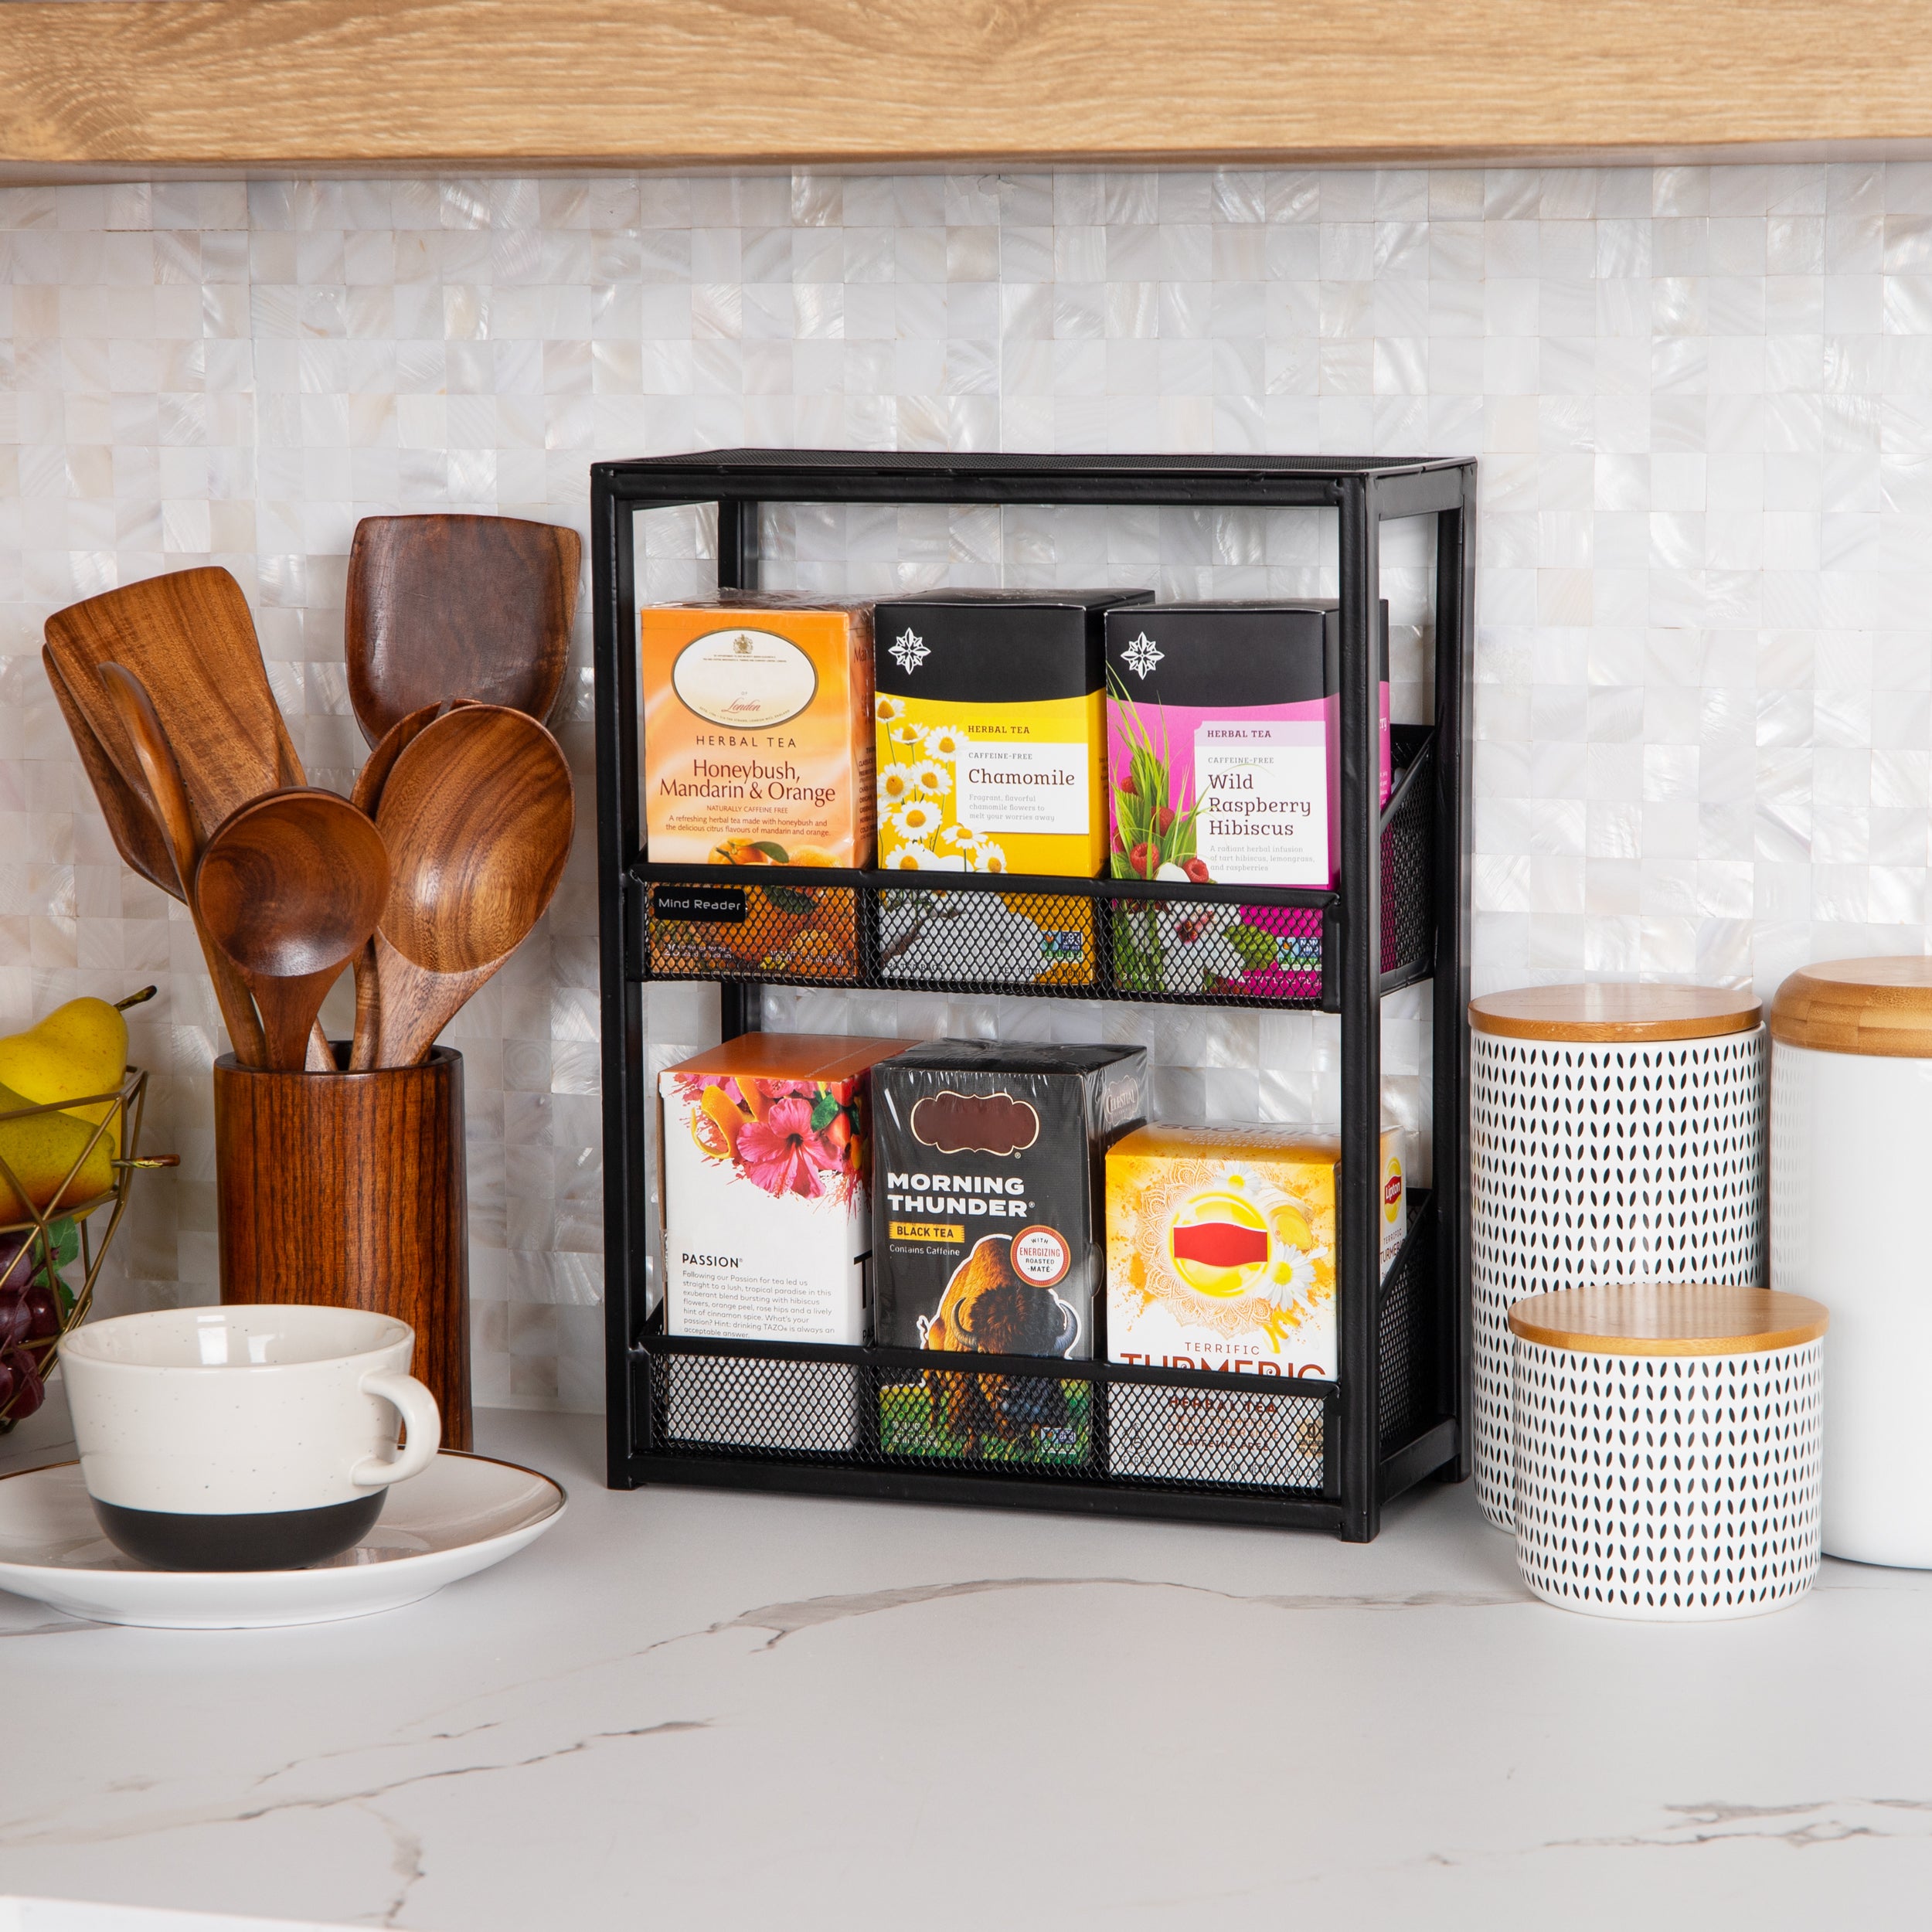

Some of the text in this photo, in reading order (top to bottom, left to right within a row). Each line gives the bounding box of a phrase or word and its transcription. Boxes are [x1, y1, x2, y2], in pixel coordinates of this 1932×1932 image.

[721, 697, 761, 714] London
[968, 725, 1007, 733] HERBAL
[1207, 730, 1248, 738] HERBAL
[696, 736, 797, 748] HERBAL TEA
[968, 752, 1033, 760] CAFFEINE-FREE
[693, 759, 800, 784] Honeybush,
[968, 768, 1075, 786] Chamomile
[1208, 774, 1254, 790] Wild
[660, 778, 744, 798] Mandarin
[750, 781, 763, 799] &
[768, 781, 835, 807] Orange
[969, 794, 1003, 802] Fragrant,
[1209, 797, 1311, 817] Raspberry
[676, 815, 707, 825] refreshing
[777, 818, 813, 827] honeybush
[1209, 819, 1294, 836] Hibiscus
[658, 898, 741, 911] Mind Reader
[887, 1172, 1025, 1196] MORNING
[1386, 1182, 1400, 1200] Lipton
[896, 1226, 954, 1238] BLACK TEA
[889, 1244, 961, 1256] Contains Caffeine
[1019, 1247, 1061, 1257] ENERGIZING
[682, 1270, 715, 1281] Following
[730, 1274, 758, 1283] Passion
[786, 1277, 798, 1286] led
[682, 1280, 710, 1290] straight
[711, 1281, 719, 1290] to
[727, 1283, 743, 1292] lush,
[745, 1284, 773, 1295] tropical
[774, 1287, 807, 1298] paradise
[817, 1288, 832, 1297] this
[682, 1290, 820, 1306] exuberant blend bursting with hibiscus
[683, 1298, 711, 1308] flowers,
[711, 1301, 736, 1311] orange
[738, 1302, 755, 1312] peel,
[774, 1304, 789, 1314] hips
[790, 1305, 805, 1314] and
[813, 1307, 832, 1316] lively
[707, 1310, 742, 1319] cinnamon
[743, 1312, 764, 1321] spice.
[683, 1318, 713, 1327] passion?
[733, 1321, 762, 1331] drinking
[797, 1325, 823, 1335] always
[684, 1326, 750, 1339] acceptable answer.
[1185, 1342, 1260, 1355] TERRIFIC
